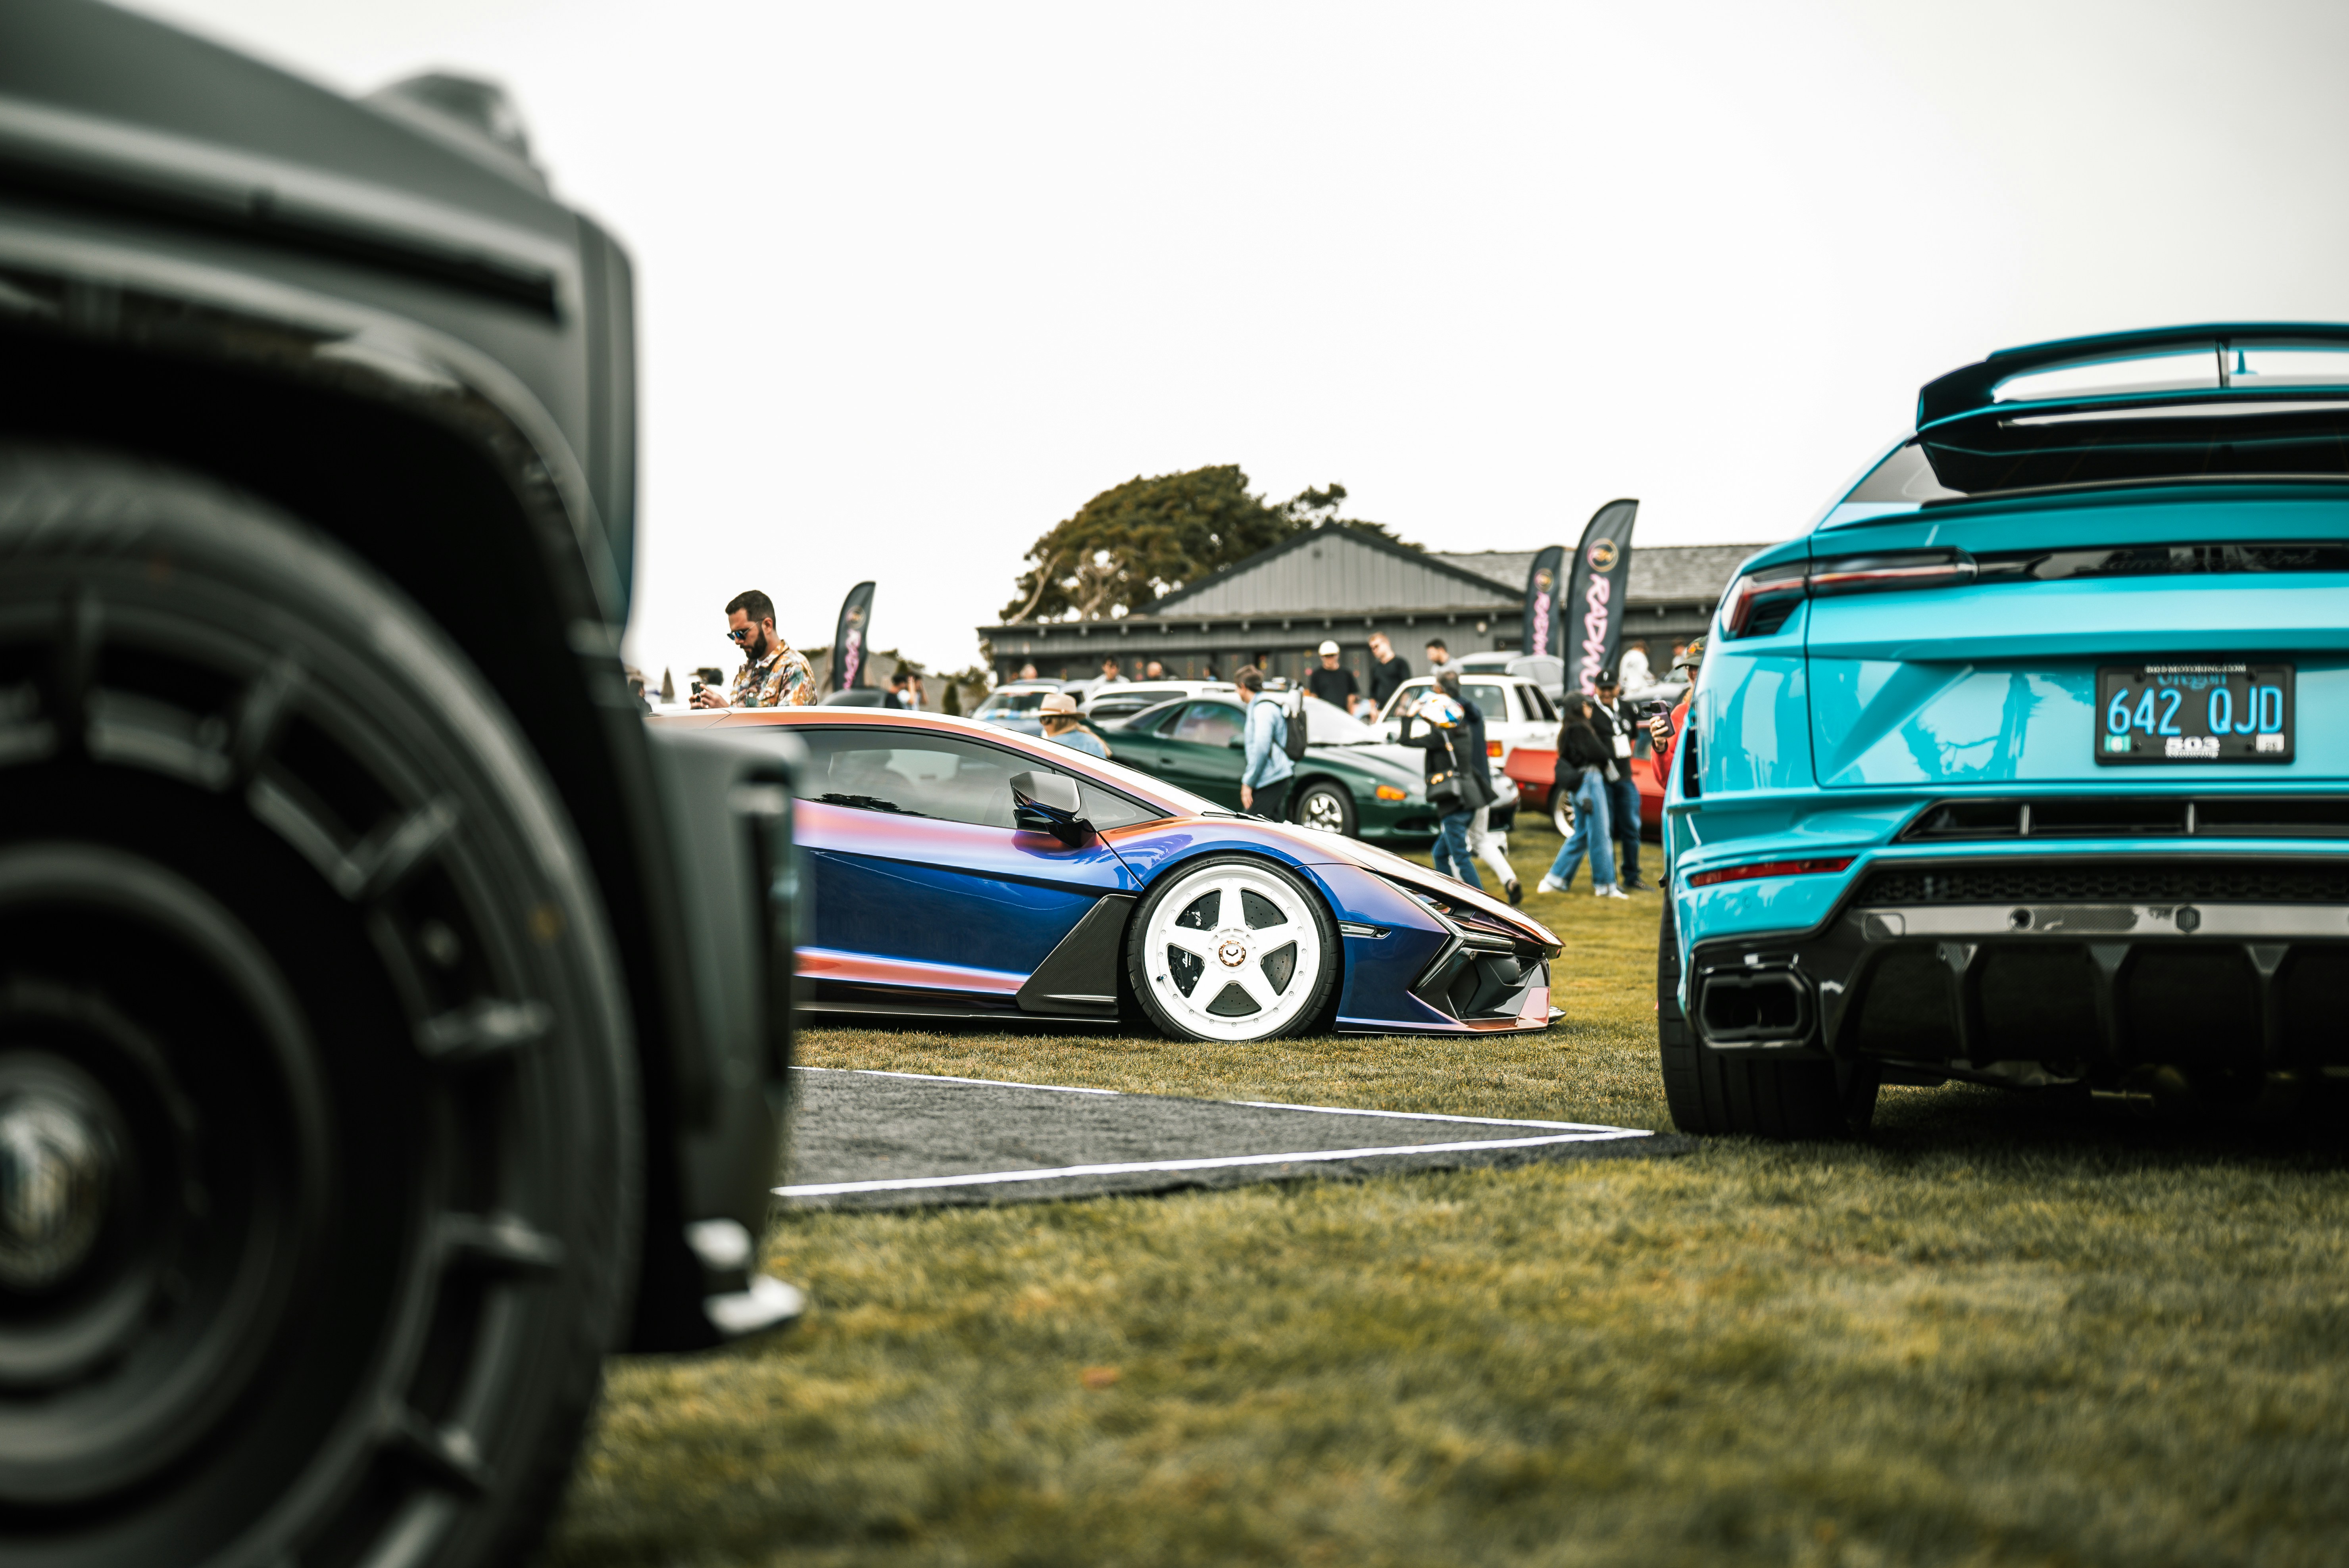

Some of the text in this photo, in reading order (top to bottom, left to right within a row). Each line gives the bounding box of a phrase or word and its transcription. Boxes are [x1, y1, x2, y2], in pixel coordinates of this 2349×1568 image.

[2107, 685, 2283, 736] 642 QJD
[2165, 736, 2220, 751] 503
[1316, 915, 1327, 943] BRIDGESTONE
